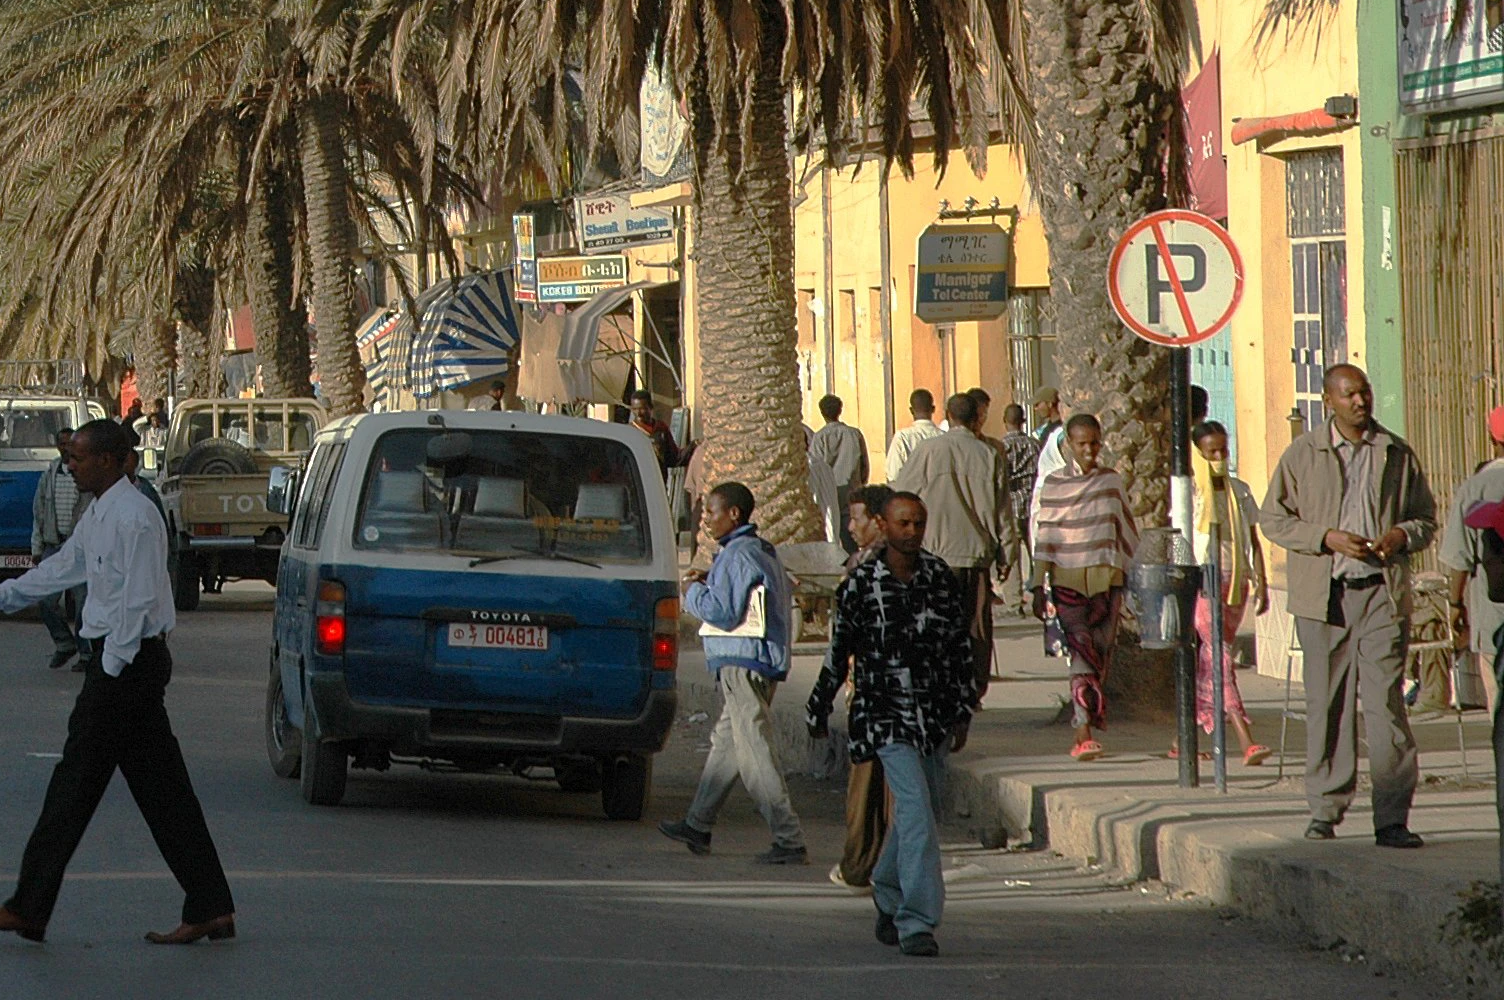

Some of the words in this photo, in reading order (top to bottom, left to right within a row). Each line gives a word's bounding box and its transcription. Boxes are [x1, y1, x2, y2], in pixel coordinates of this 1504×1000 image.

[935, 271, 993, 288] Mamiger
[1145, 244, 1207, 324] P
[542, 285, 572, 296] KOKEB
[932, 288, 950, 300] Tel
[951, 288, 990, 300] Center
[219, 495, 267, 513] TOY
[471, 610, 531, 622] TOYOTA
[485, 626, 536, 646] 00481
